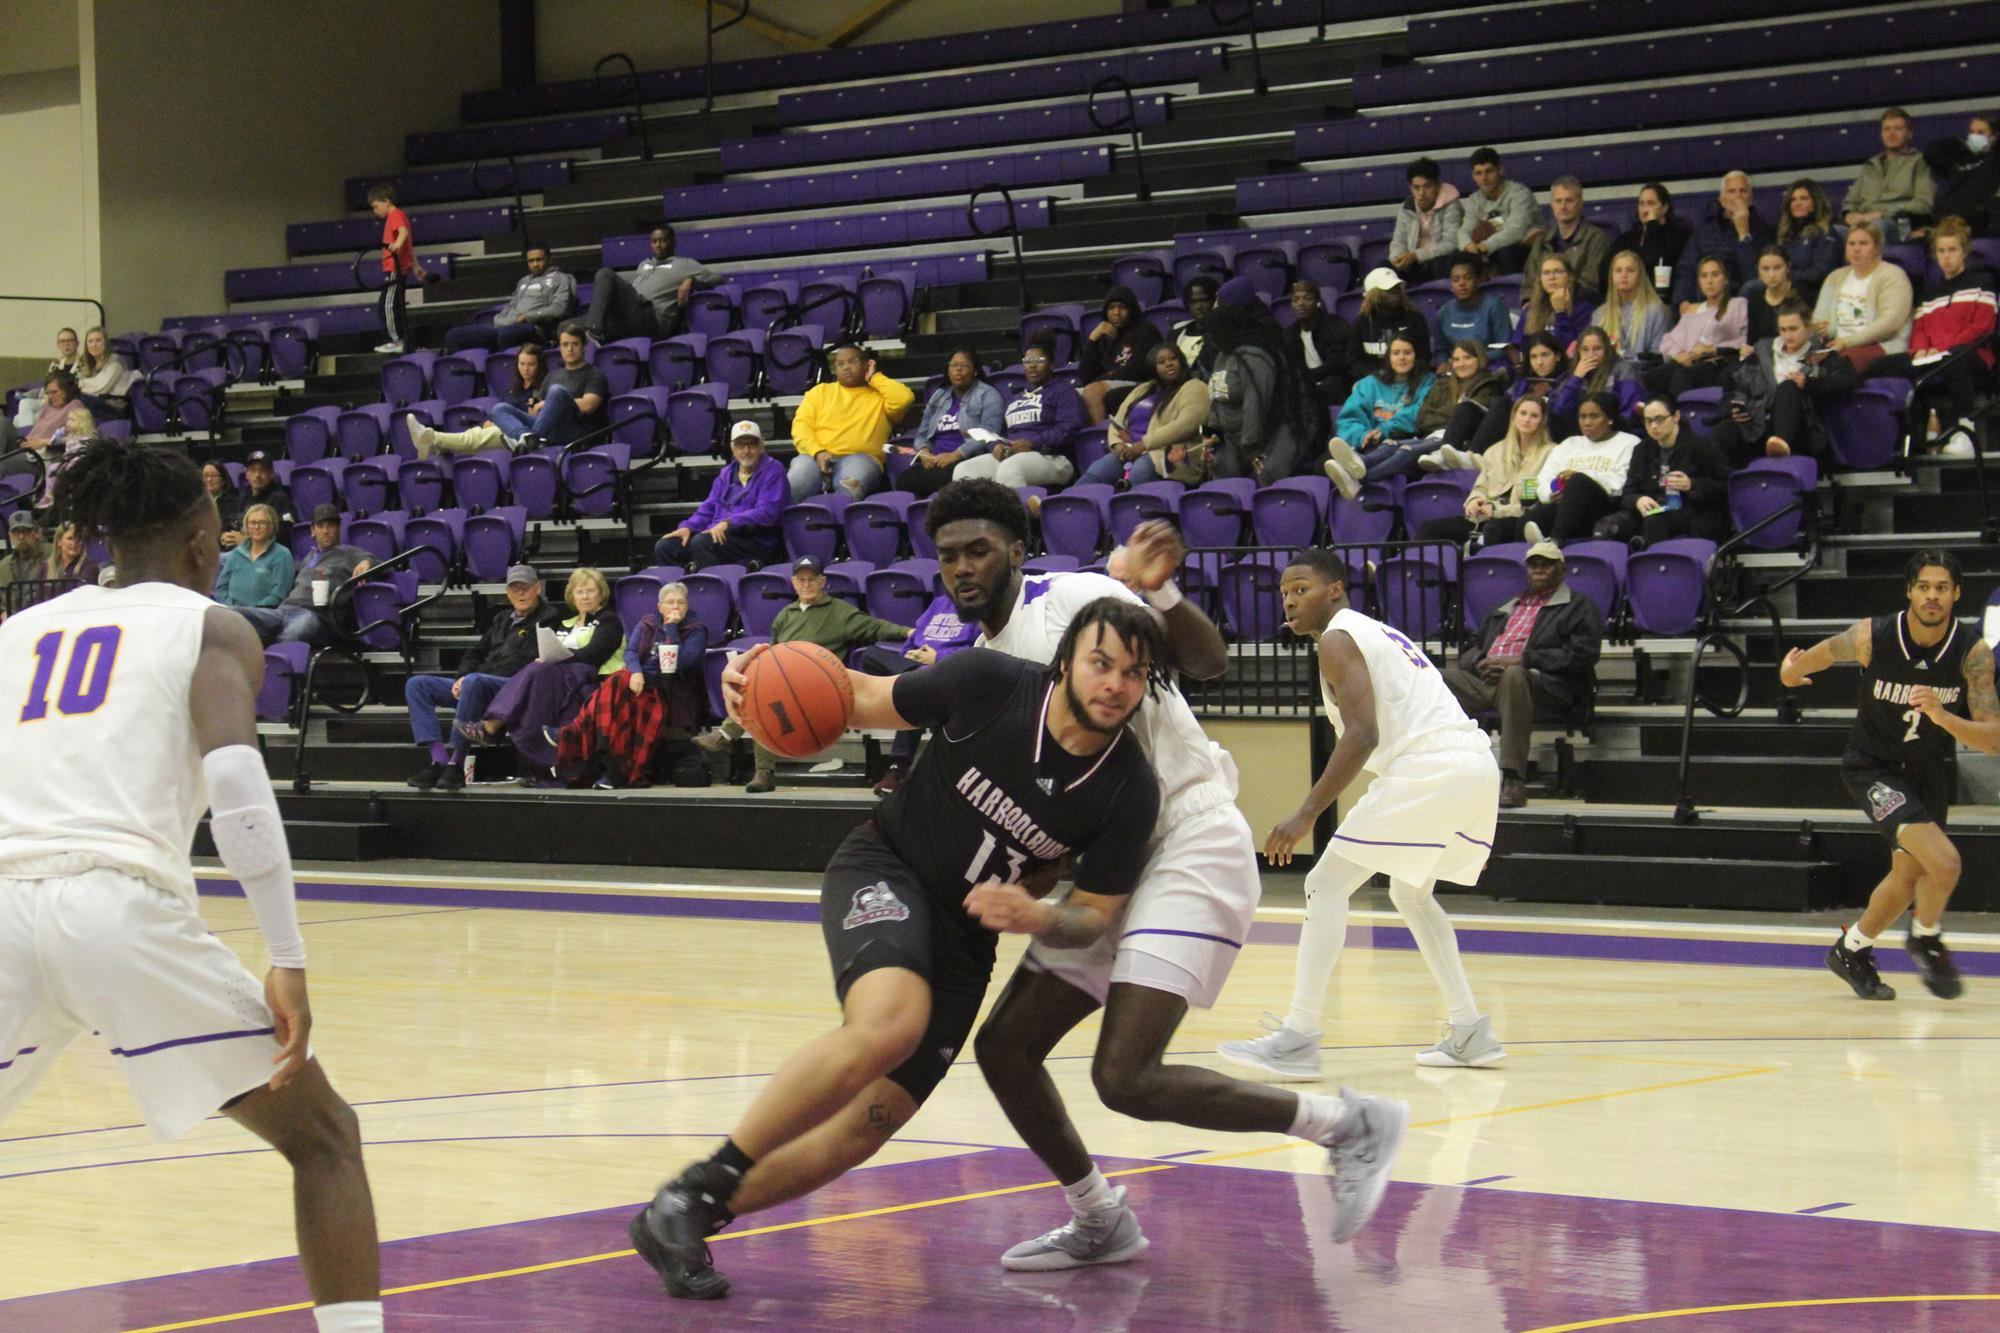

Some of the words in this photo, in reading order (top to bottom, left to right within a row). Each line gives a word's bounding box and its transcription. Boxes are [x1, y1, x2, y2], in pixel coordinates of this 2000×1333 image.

[17, 624, 125, 726] 10
[1873, 679, 1961, 705] HARRURG
[1902, 710, 1921, 742] 2
